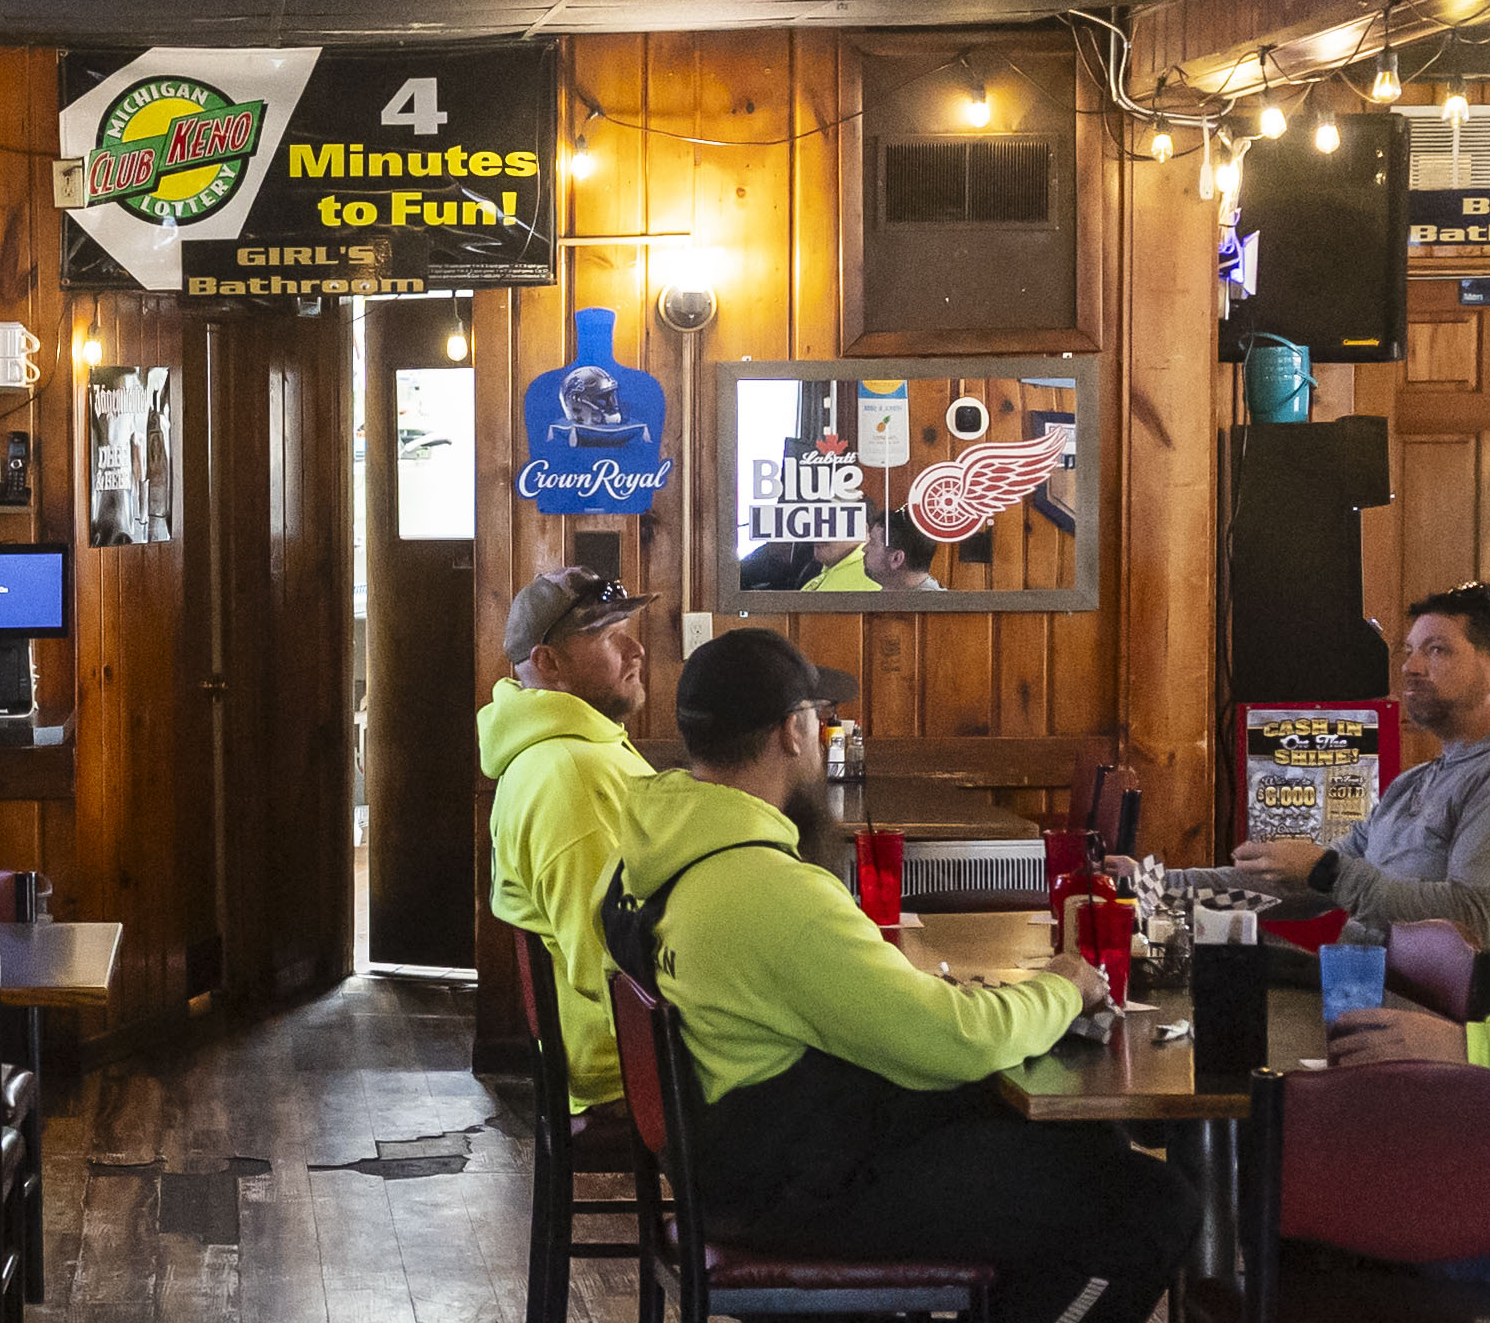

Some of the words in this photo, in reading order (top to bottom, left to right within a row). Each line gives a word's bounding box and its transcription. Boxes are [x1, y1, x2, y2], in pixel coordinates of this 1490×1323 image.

[107, 81, 209, 139] MICHIGAN
[380, 77, 448, 135] 4
[89, 149, 156, 197] CLUB
[166, 112, 253, 166] KENO
[289, 143, 538, 177] Minutes
[139, 164, 238, 217] LOTTERY
[318, 195, 378, 227] to
[392, 191, 518, 226] Fun!
[237, 246, 376, 266] GIRL'S
[188, 276, 424, 295] Bathroom
[1463, 292, 1484, 301] Men
[799, 451, 858, 465] Labatt
[518, 459, 592, 497] Crown
[578, 459, 672, 500] Royal
[753, 457, 864, 501] Blue
[751, 506, 863, 538] LIGHT
[1263, 718, 1329, 737] CASH
[1337, 719, 1363, 736] IN
[1274, 747, 1360, 767] SHINE!
